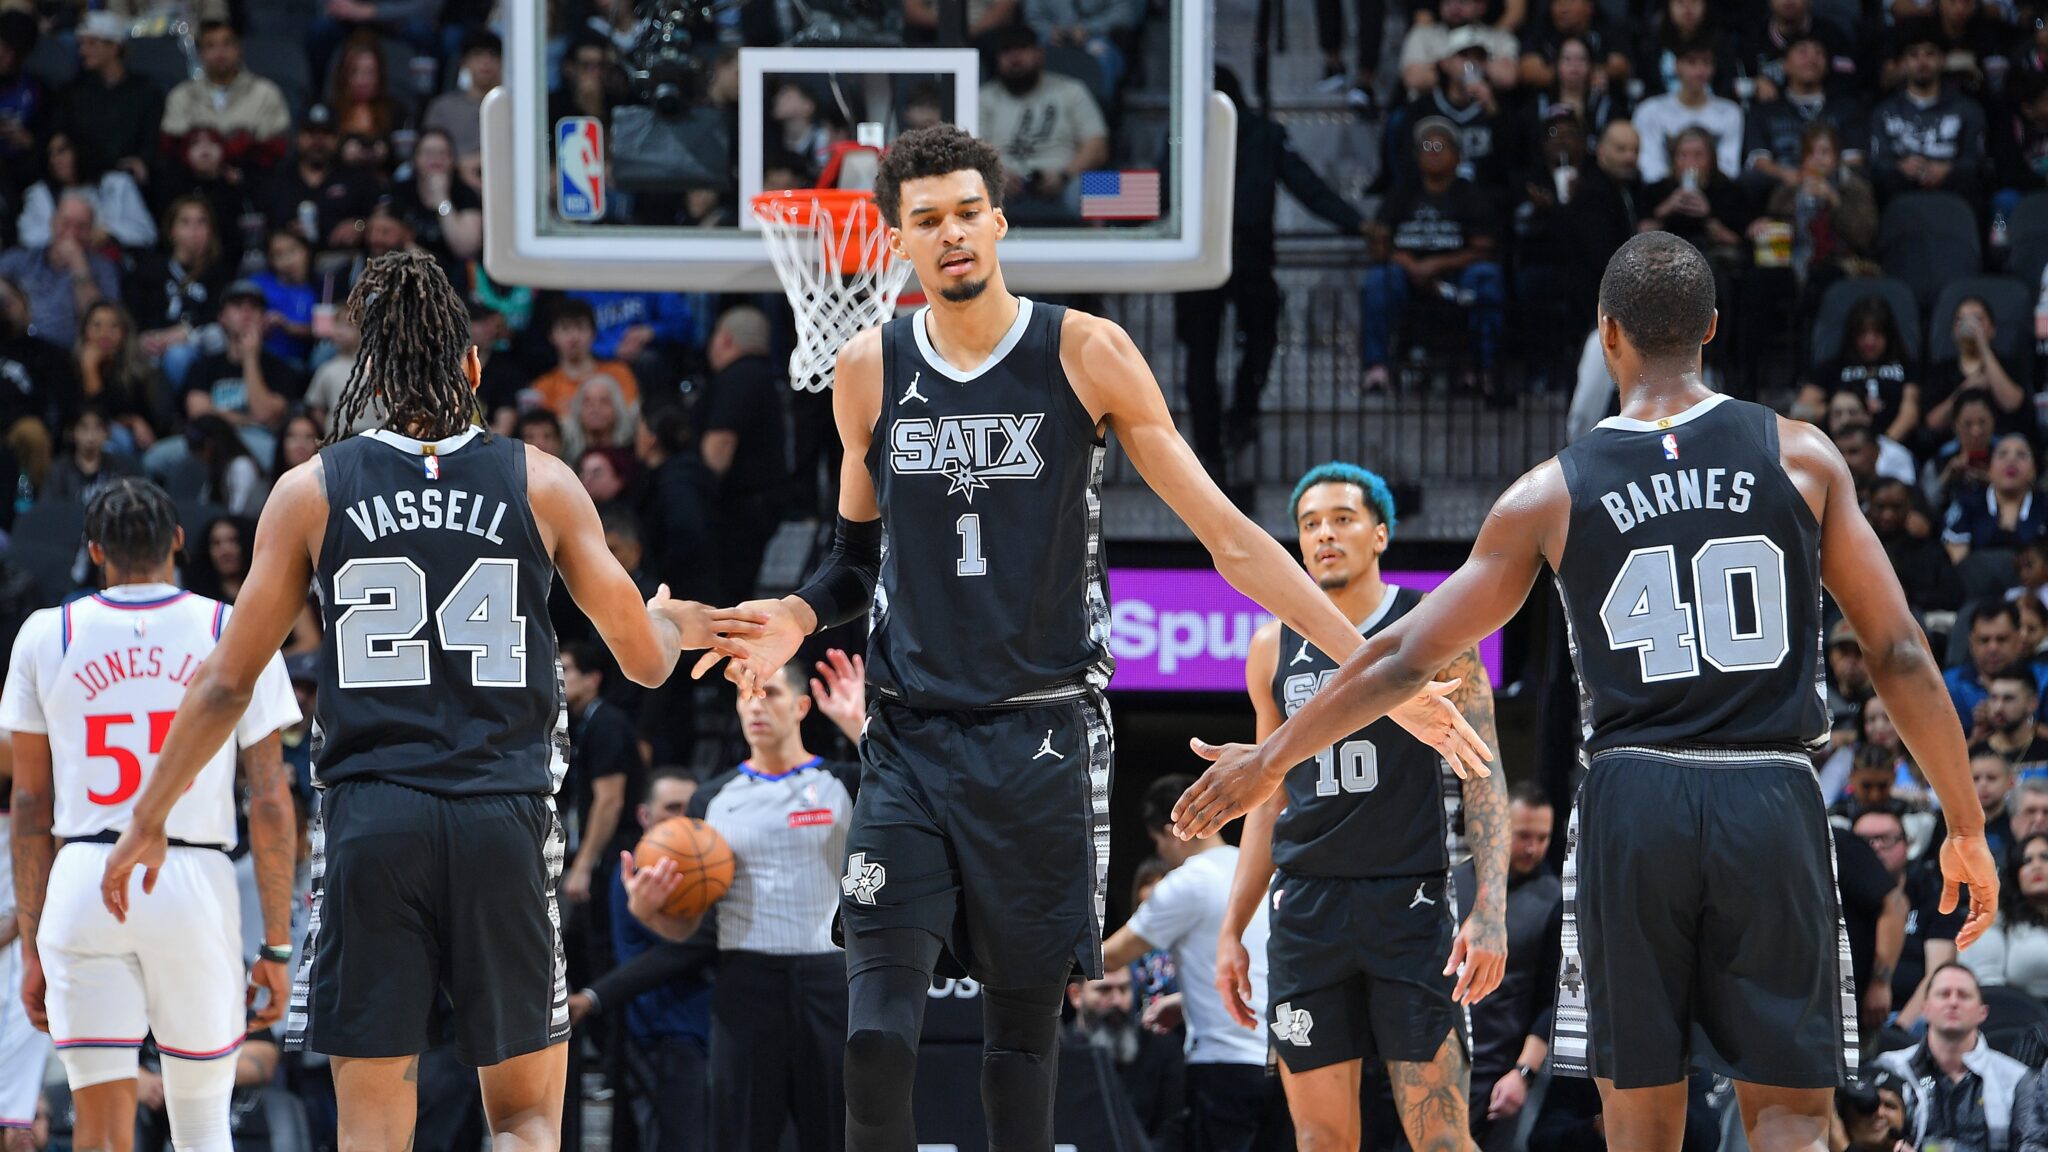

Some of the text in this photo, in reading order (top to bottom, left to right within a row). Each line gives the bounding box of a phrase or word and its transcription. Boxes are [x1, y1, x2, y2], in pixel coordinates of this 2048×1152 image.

[890, 413, 1045, 480] SATX
[345, 489, 507, 545] VASSELL
[1600, 468, 1755, 534] BARNES
[956, 513, 987, 577] 1
[333, 556, 527, 688] 24
[1599, 535, 1790, 684] 40
[73, 646, 204, 701] JONES J
[1315, 739, 1379, 797] 10
